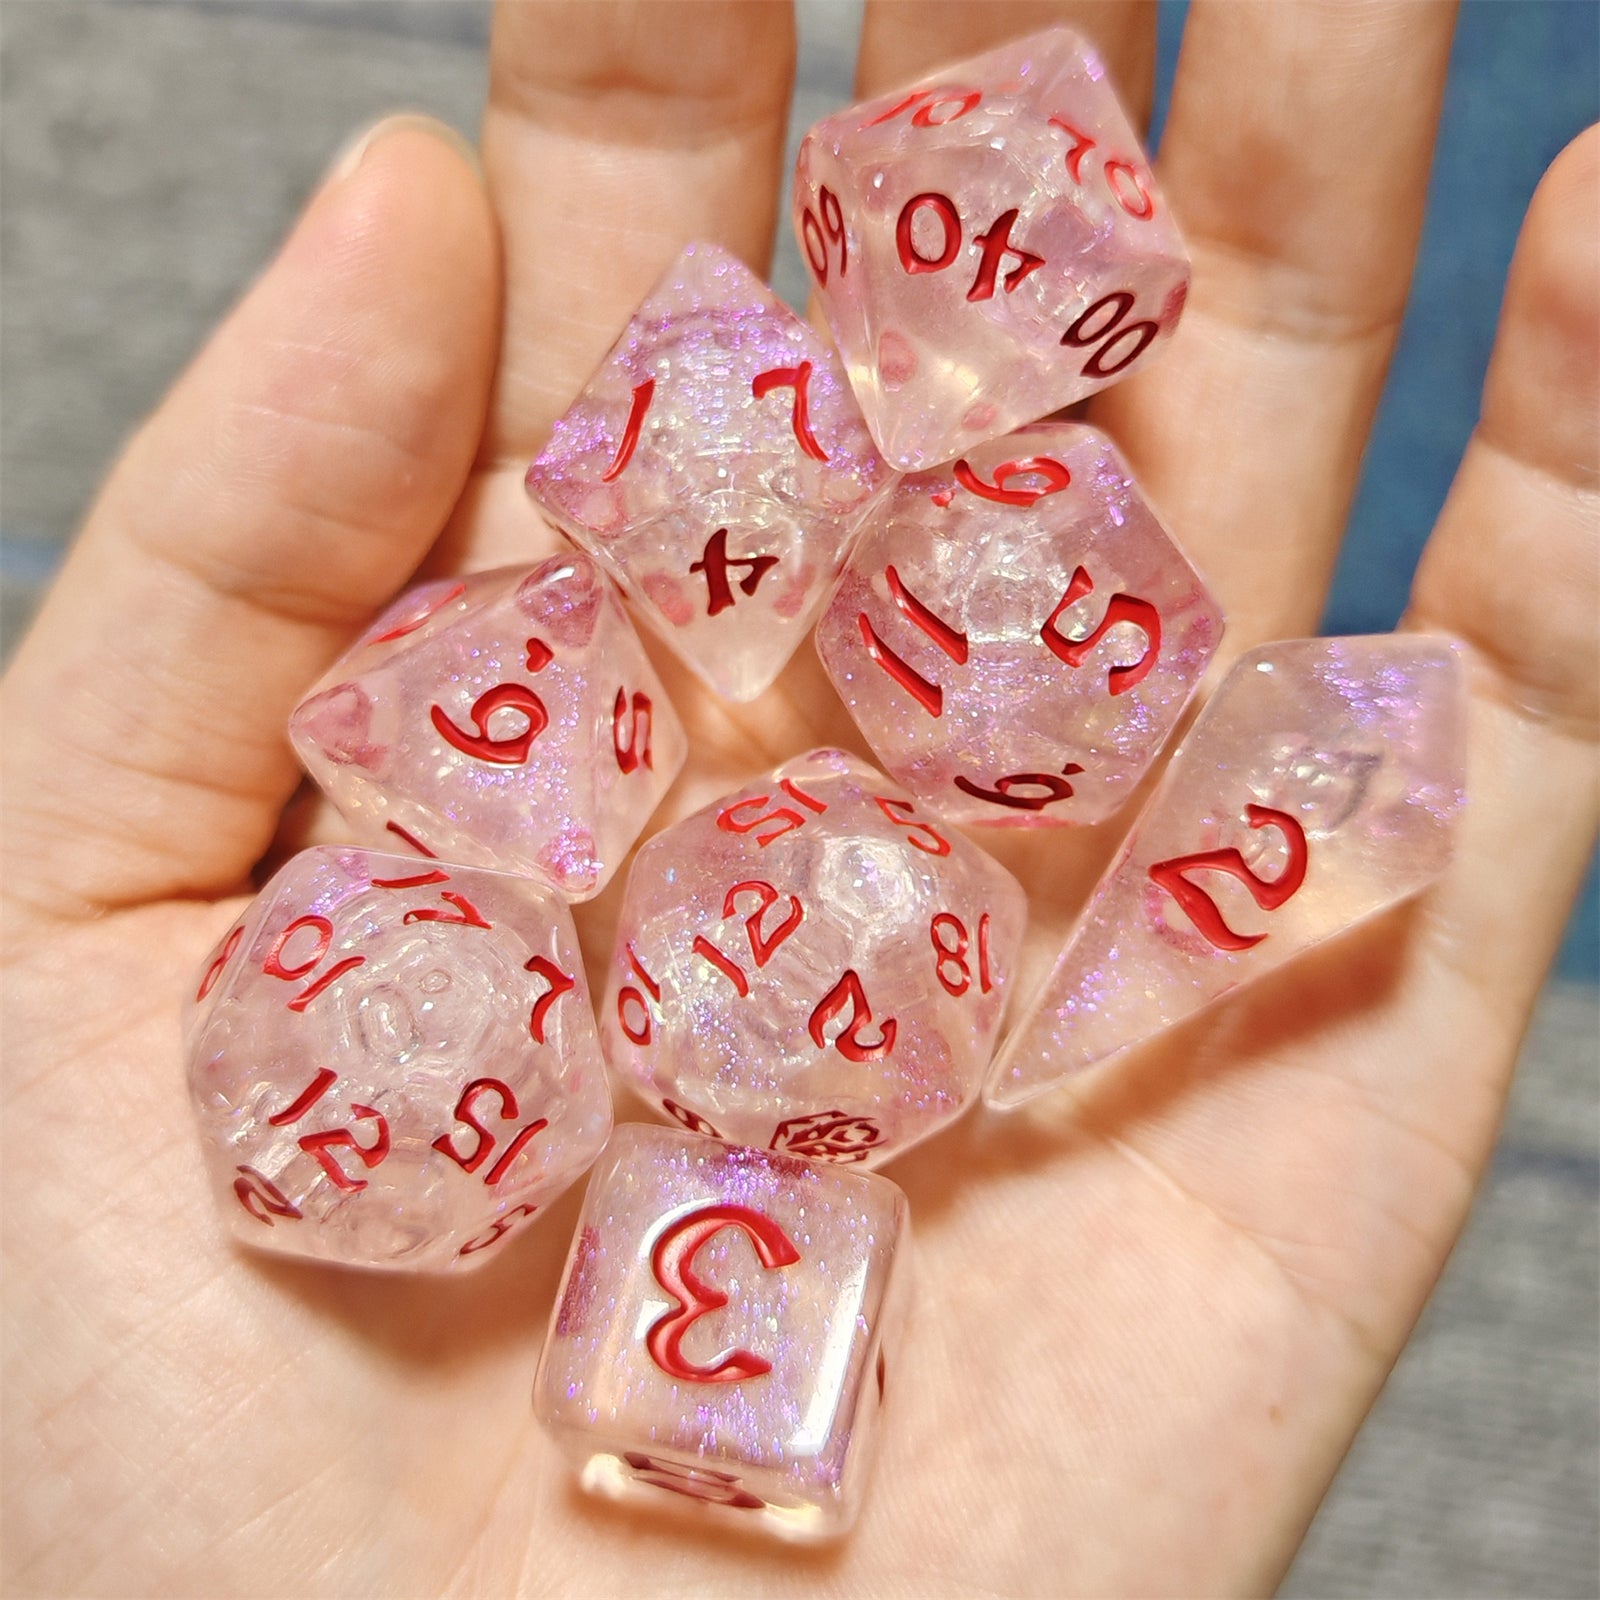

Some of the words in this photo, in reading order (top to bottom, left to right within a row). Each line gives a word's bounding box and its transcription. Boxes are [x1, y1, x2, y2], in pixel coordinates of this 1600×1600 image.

[858, 86, 983, 128] 10
[1048, 116, 1154, 222] 70
[895, 192, 1046, 303] 40
[1060, 292, 1160, 379] 00
[602, 378, 656, 483] 1
[752, 361, 831, 463] 7
[689, 528, 780, 617] 4
[857, 564, 969, 718] 11
[1040, 565, 1162, 697] 5
[716, 778, 828, 848] 15
[873, 796, 952, 857] 5
[1148, 802, 1309, 951] 2
[262, 914, 367, 1012] 10
[691, 880, 803, 998] 12
[930, 912, 993, 997] 18
[524, 954, 576, 1045] 7
[617, 943, 662, 1046] 10
[808, 969, 898, 1062] 2
[268, 1067, 391, 1193] 12
[431, 1077, 549, 1186] 15
[646, 1203, 802, 1385] 3
